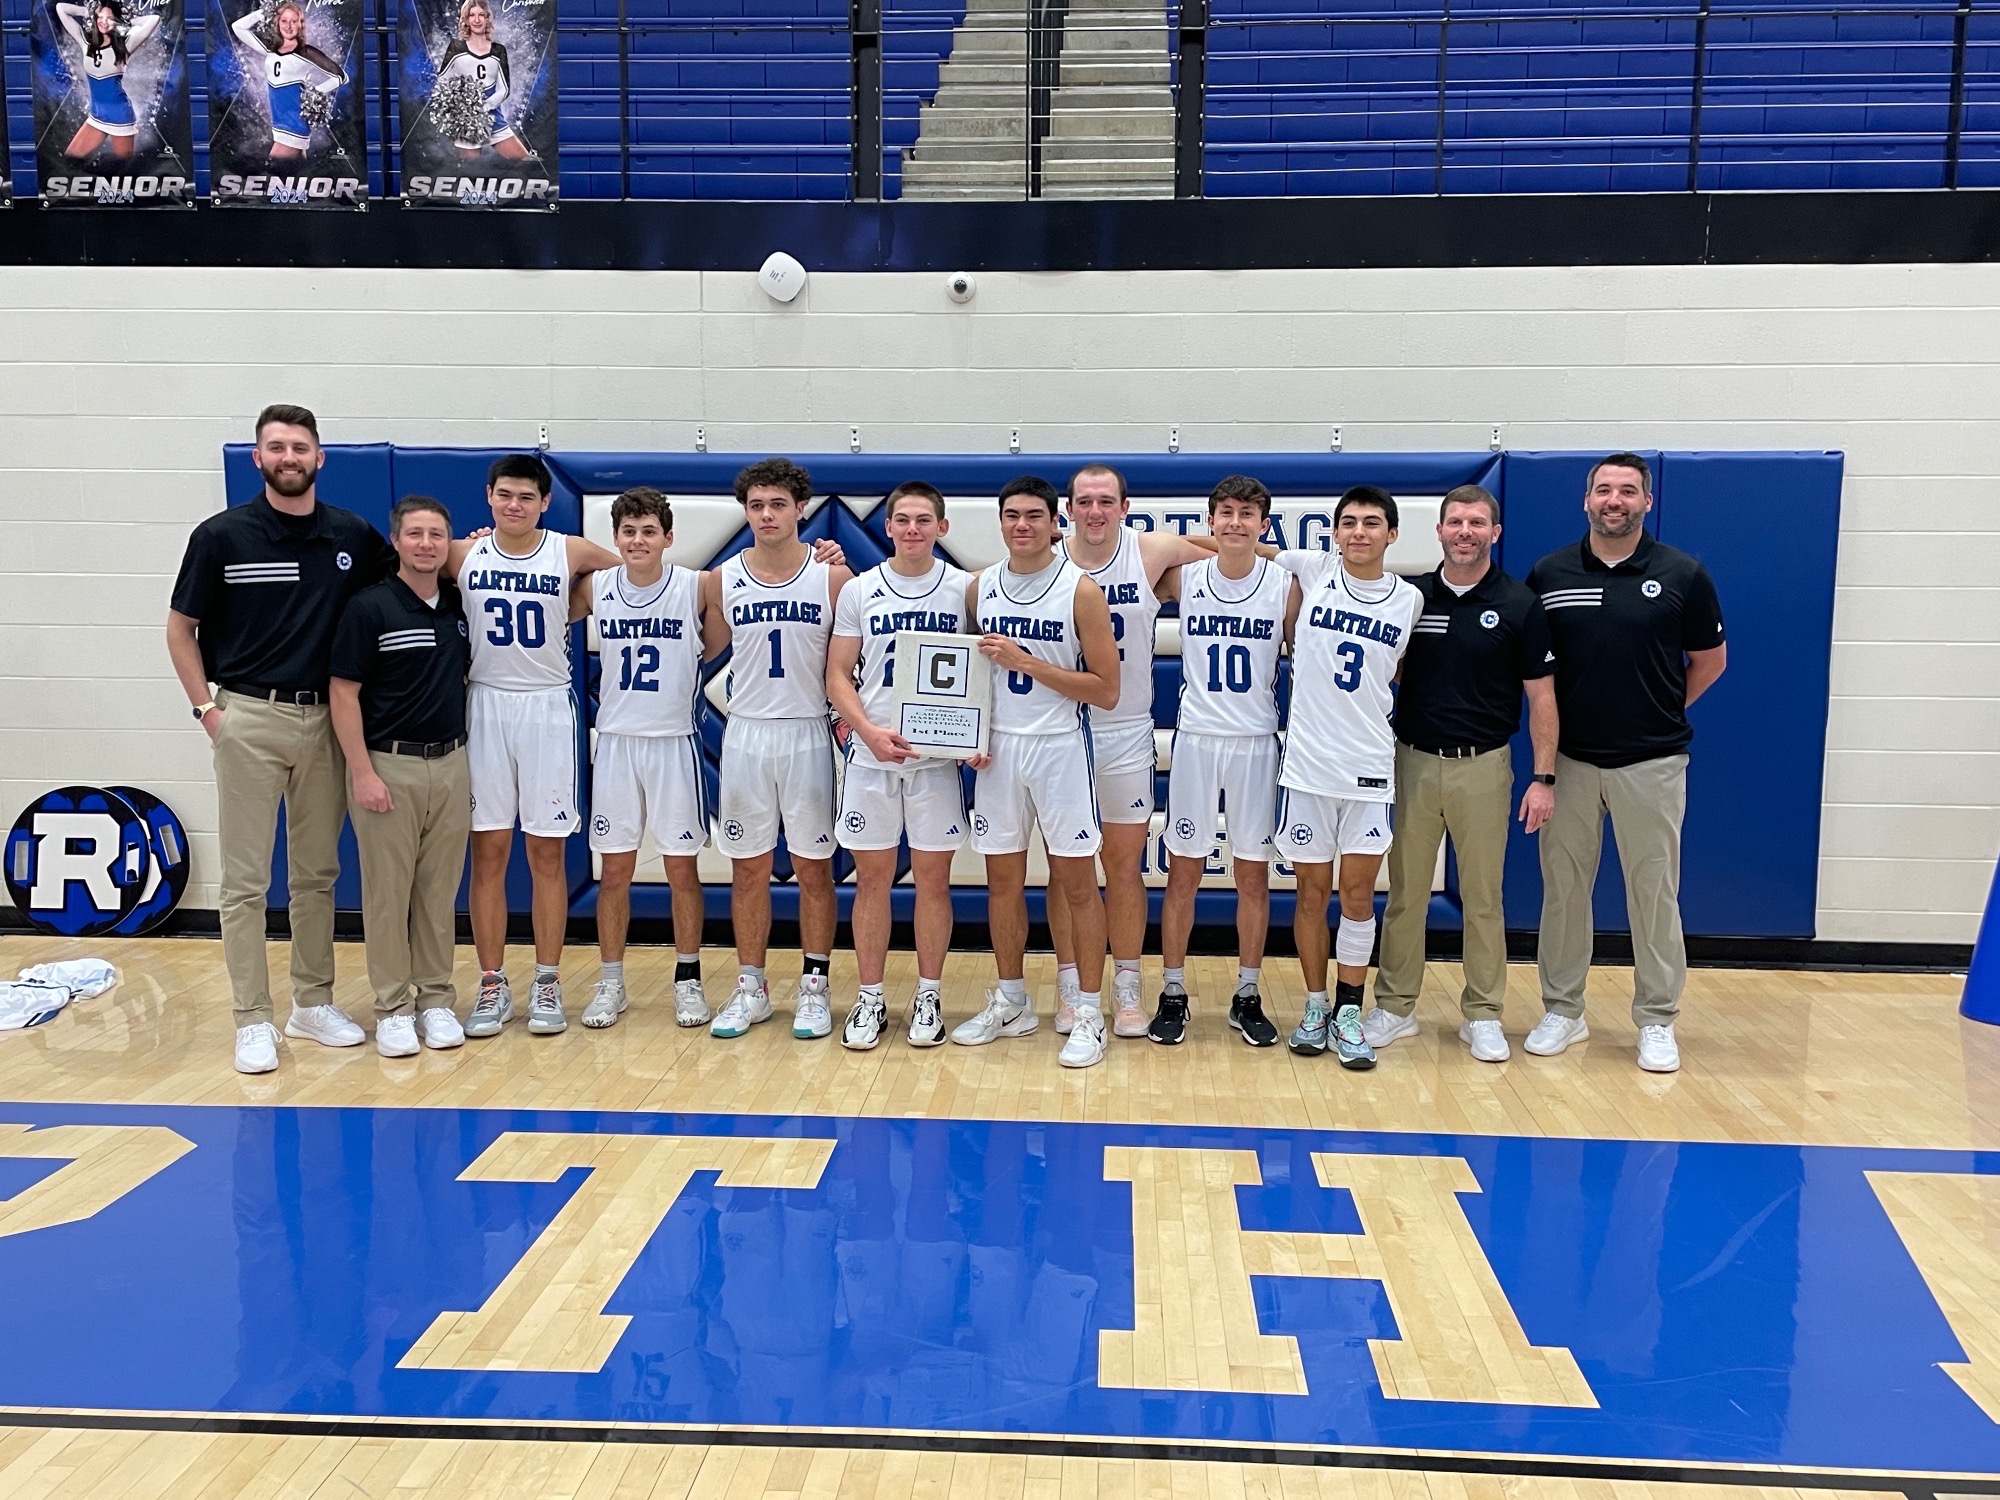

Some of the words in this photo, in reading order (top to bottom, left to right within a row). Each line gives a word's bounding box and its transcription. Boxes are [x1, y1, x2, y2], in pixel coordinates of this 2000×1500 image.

[273, 61, 281, 77] C
[476, 64, 486, 80] C
[46, 176, 186, 198] SENIOR
[97, 189, 135, 204] 2024
[217, 175, 360, 199] SENIOR
[270, 189, 309, 204] 2024
[407, 176, 550, 200] SENIOR
[459, 190, 498, 205] 2024
[340, 556, 348, 566] C
[468, 570, 561, 597] CARTHAGE
[1647, 584, 1656, 593] C
[732, 600, 822, 626] CARTHAGE
[1485, 614, 1495, 625] C
[484, 597, 546, 649] 30
[599, 617, 683, 640] CARTHAGE
[869, 610, 958, 636] CARTHAGE
[982, 616, 1064, 643] CARTHAGE
[1187, 615, 1274, 641] CARTHAGE
[1309, 605, 1402, 649] CARTHAGE
[768, 628, 785, 678] 1
[619, 645, 660, 692] 12
[930, 652, 957, 690] C
[1207, 643, 1251, 693] 10
[1333, 641, 1365, 693] 3
[907, 719, 974, 728] INVITATIONAL
[915, 711, 967, 719] CARTHAGE
[933, 729, 968, 737] Place
[596, 820, 604, 831] C
[729, 825, 737, 836] C
[850, 815, 859, 828] C
[976, 820, 983, 831] C
[1181, 823, 1189, 834] C
[1296, 828, 1306, 840] C
[30, 813, 121, 910] R
